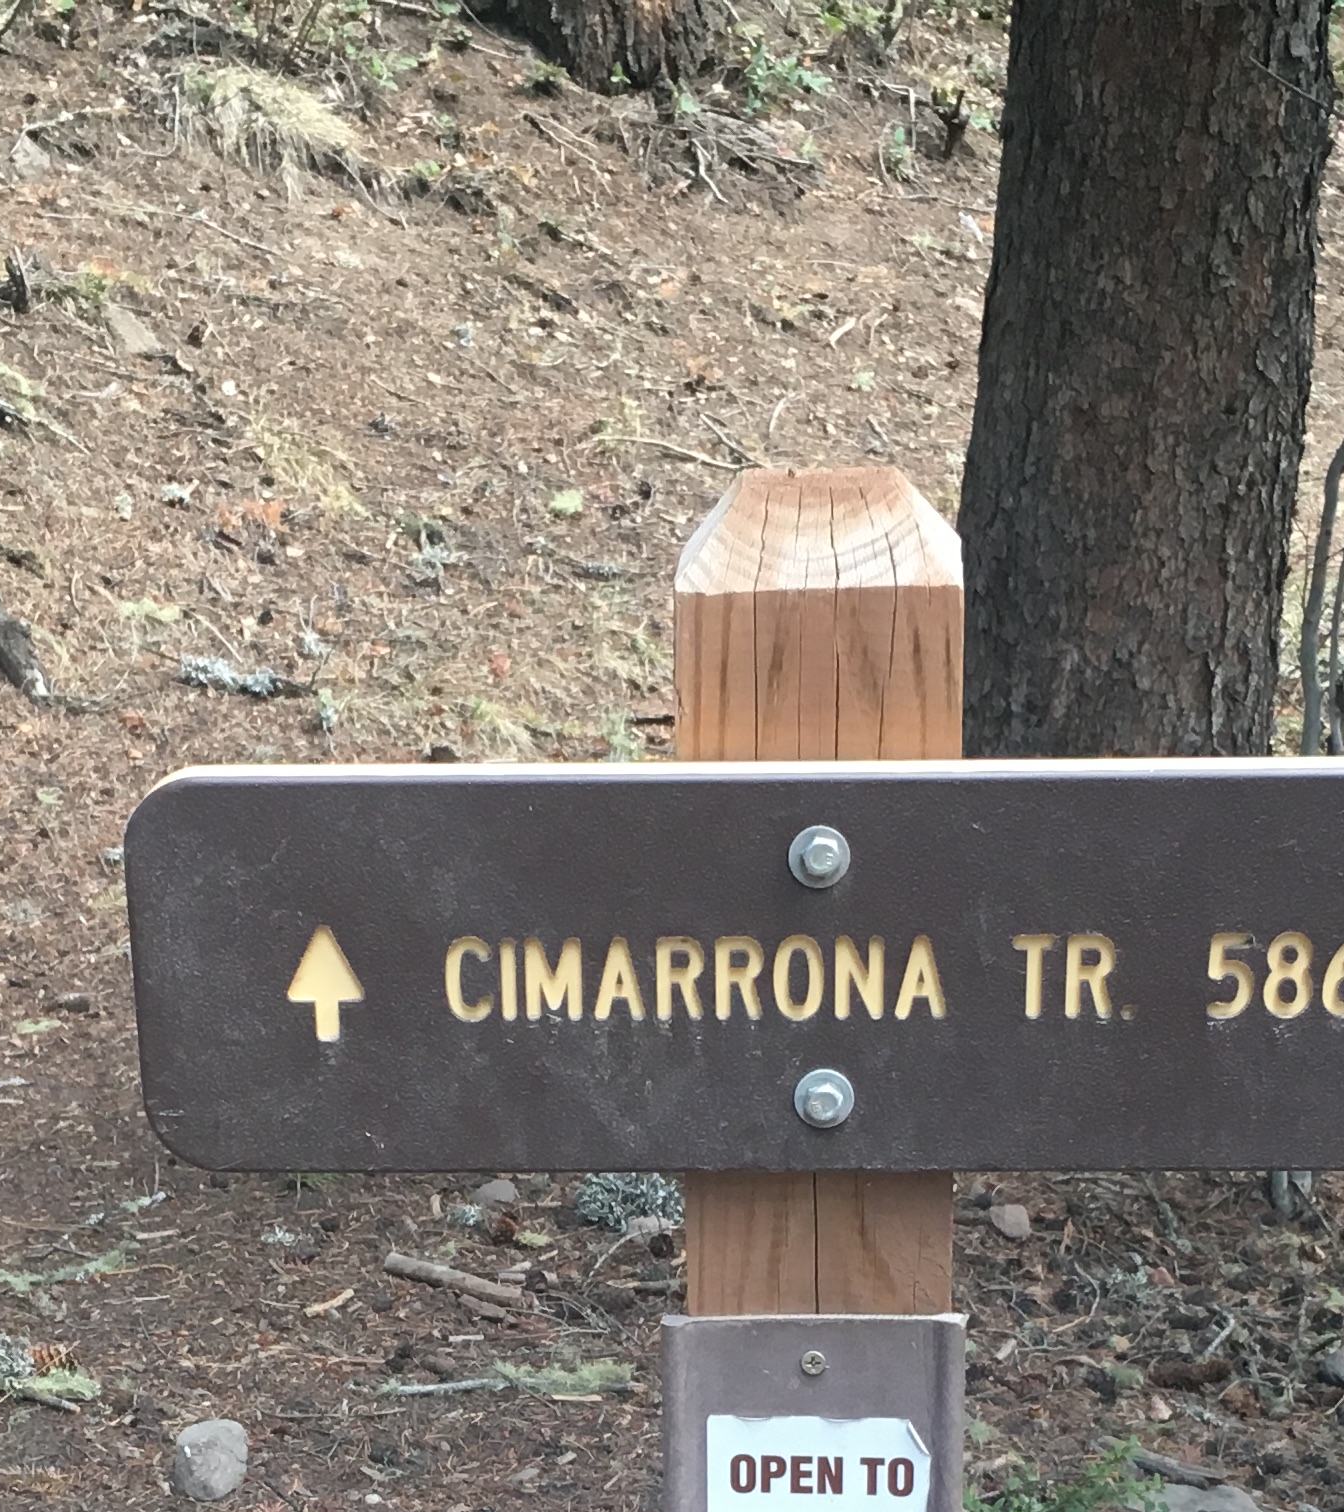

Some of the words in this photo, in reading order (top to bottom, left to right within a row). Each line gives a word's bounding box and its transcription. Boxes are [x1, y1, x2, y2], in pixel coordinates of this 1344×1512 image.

[445, 934, 947, 1022] CIMARRONA
[730, 1454, 843, 1494] OPEN
[860, 1457, 914, 1497] TO
